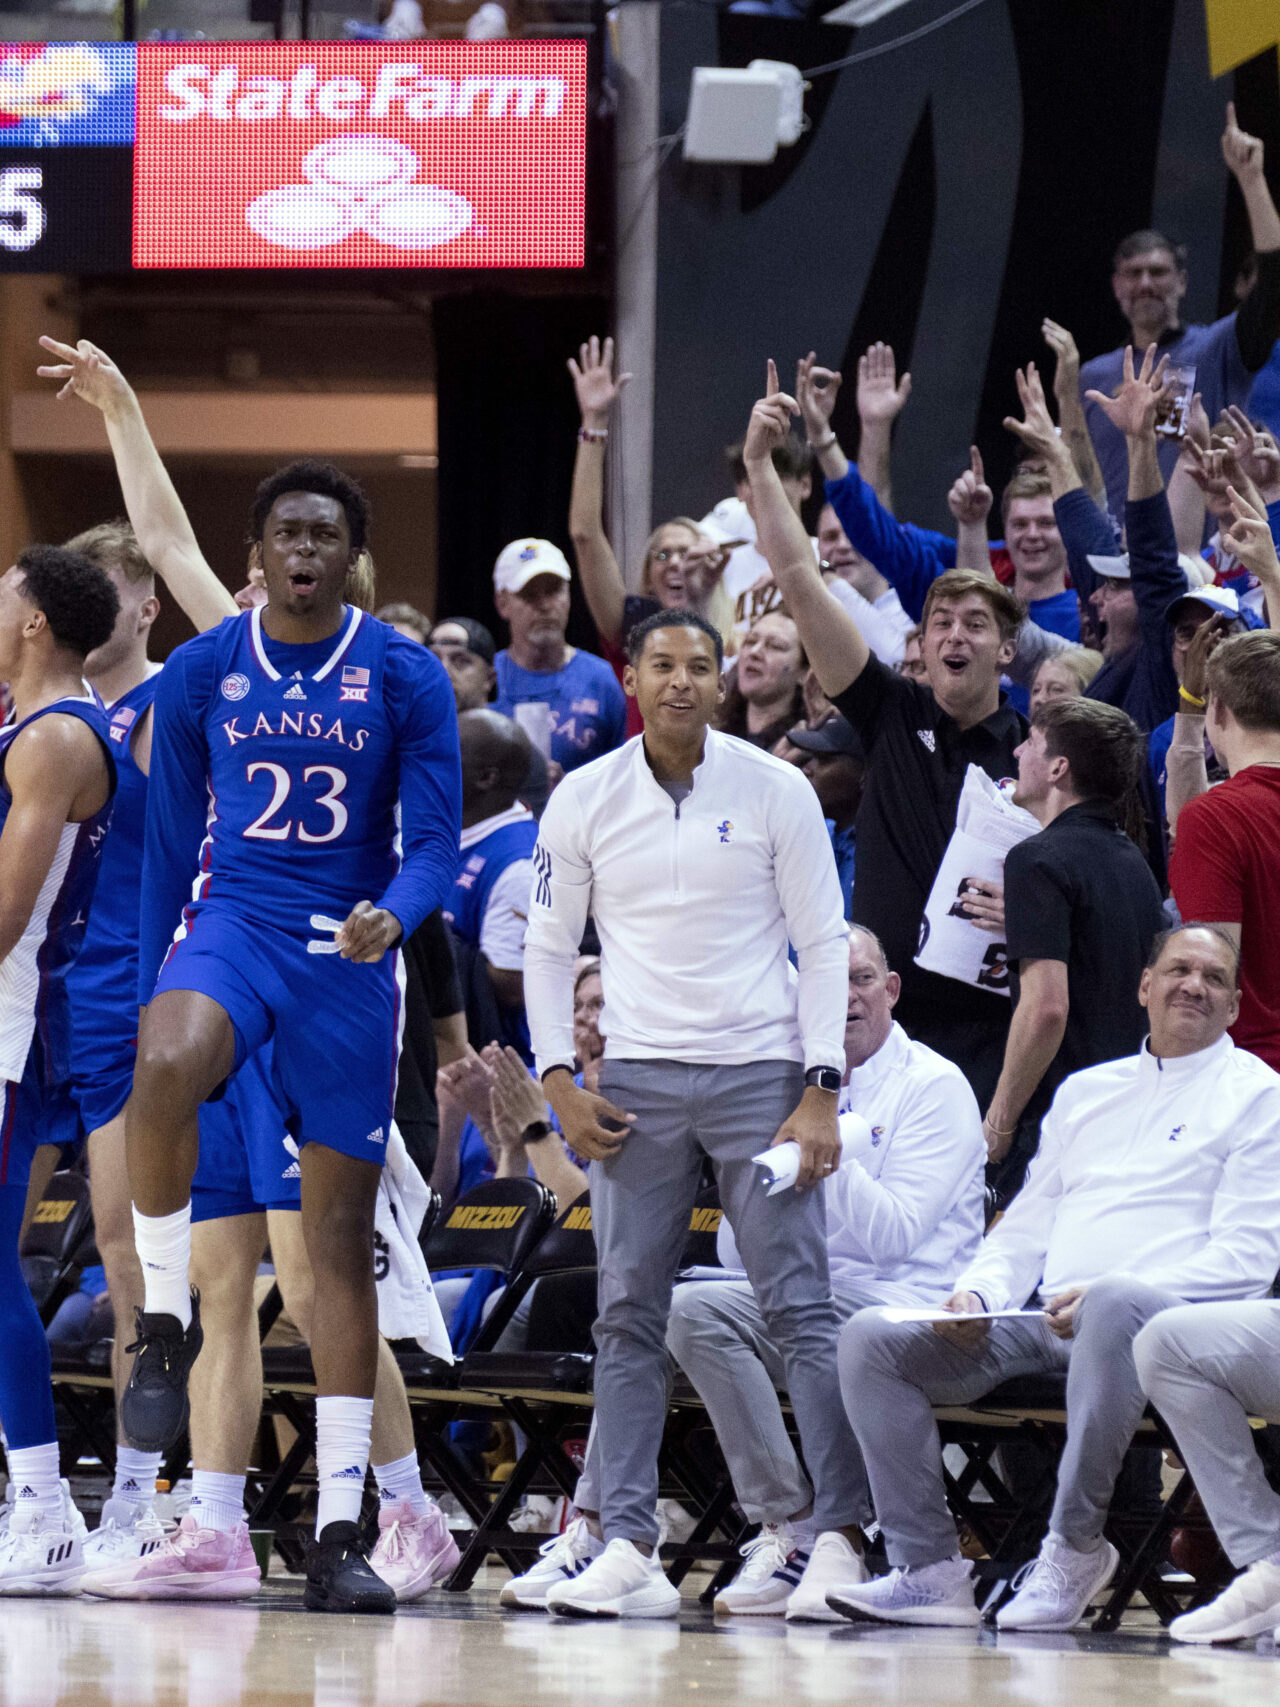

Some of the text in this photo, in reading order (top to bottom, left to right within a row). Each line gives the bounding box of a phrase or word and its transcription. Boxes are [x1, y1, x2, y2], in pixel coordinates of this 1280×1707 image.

[222, 710, 370, 751] KANSAS
[242, 761, 349, 843] 23
[445, 1206, 526, 1230] MIZZOU
